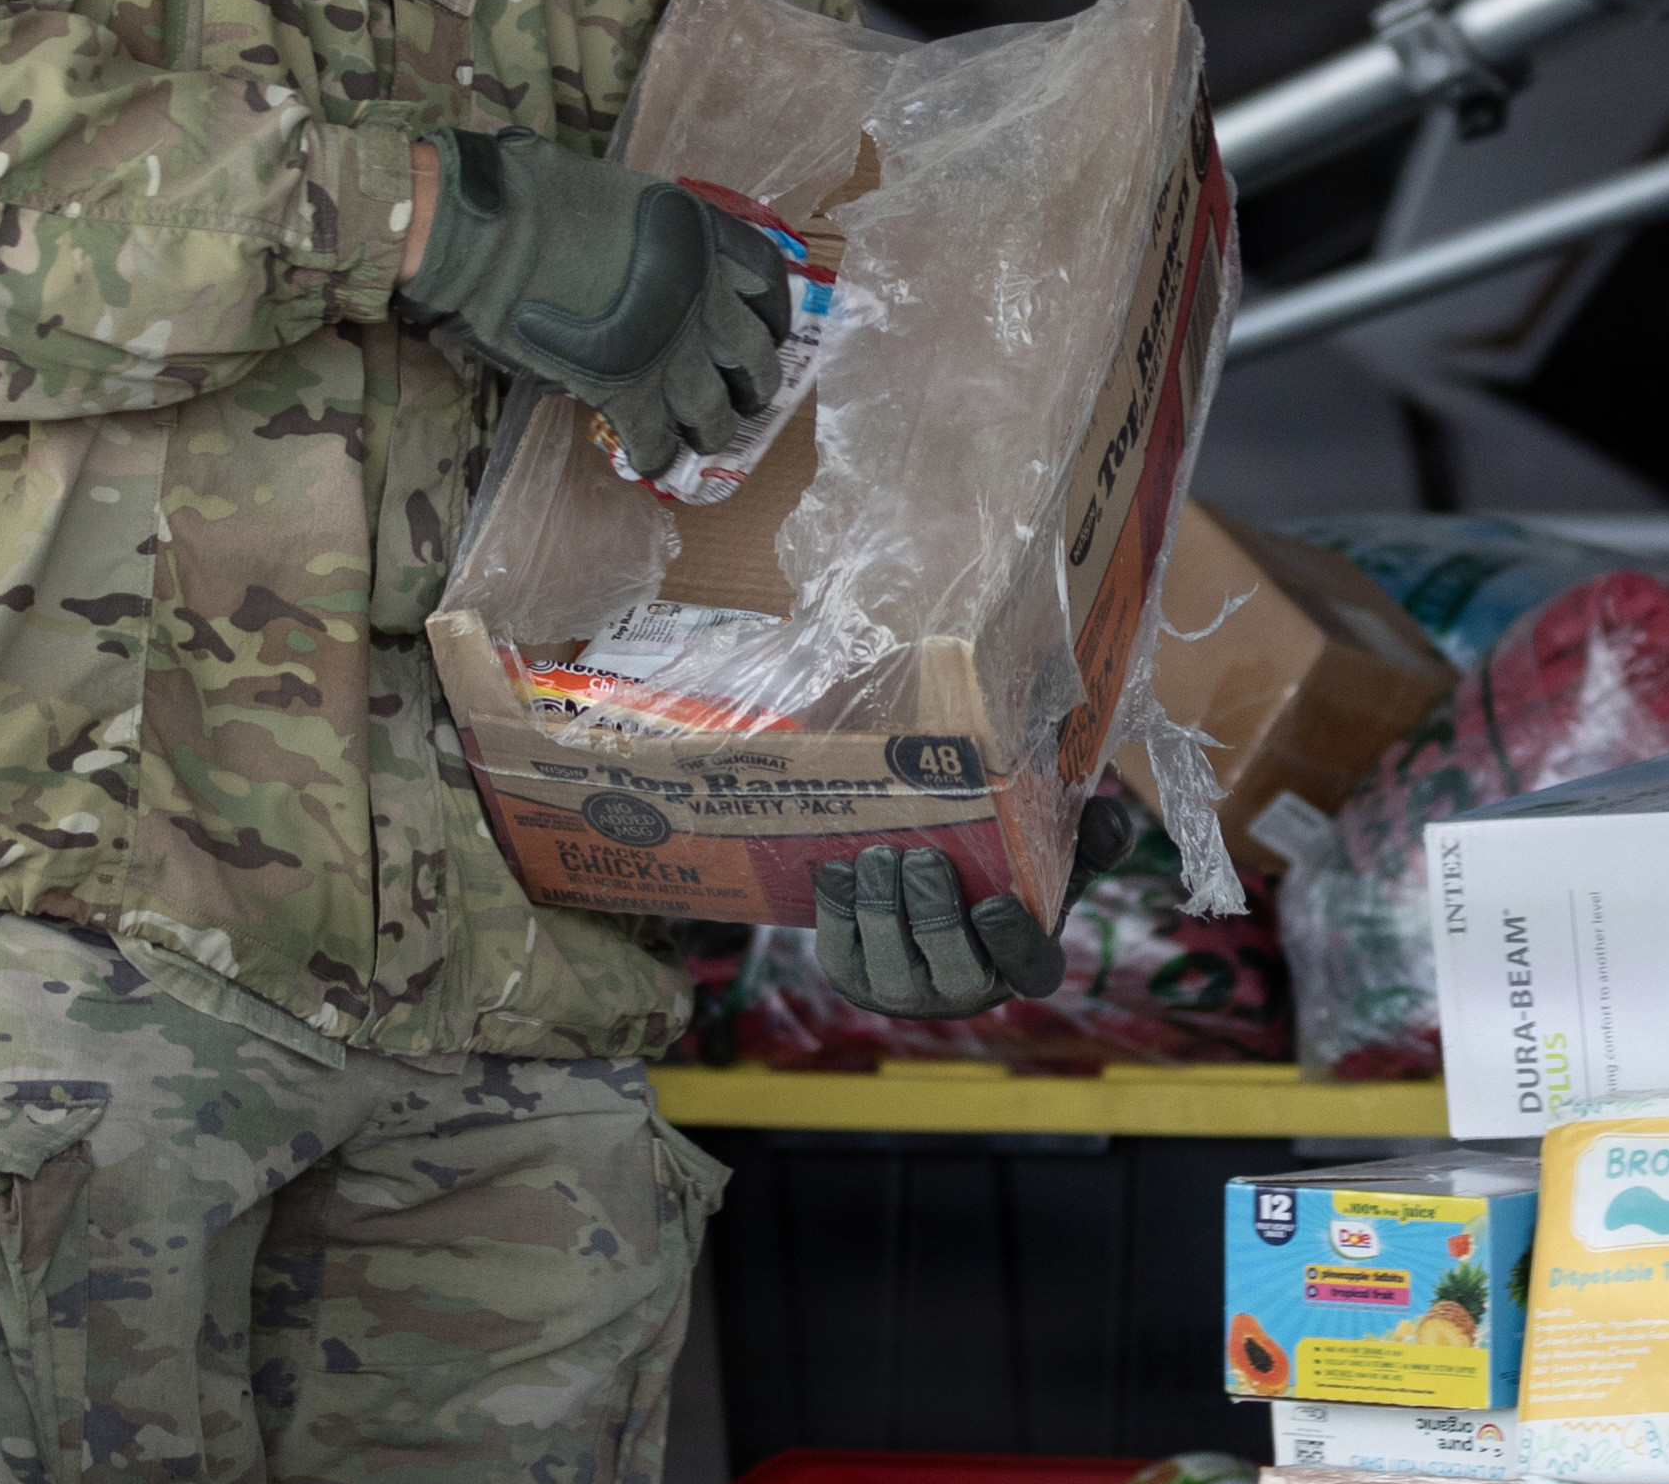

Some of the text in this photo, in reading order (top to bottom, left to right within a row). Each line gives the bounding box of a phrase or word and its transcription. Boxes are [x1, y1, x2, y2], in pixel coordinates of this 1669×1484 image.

[1098, 176, 1190, 500] Top Ramen
[713, 751, 787, 770] ORIGINAL
[918, 744, 963, 776] 48
[595, 762, 894, 805] Top Ramen
[922, 772, 966, 785] PACK
[598, 814, 657, 828] ADDED
[605, 802, 630, 814] NO
[687, 799, 857, 817] VARIETY PACK
[615, 825, 654, 839] MSG
[559, 851, 703, 886] CHICKEN
[1439, 836, 1468, 936] INTEX
[1503, 914, 1545, 1115] DURA-BEAM
[1258, 1193, 1293, 1222] 12
[1338, 1228, 1374, 1248] Dole
[1548, 1264, 1656, 1291] Disposable
